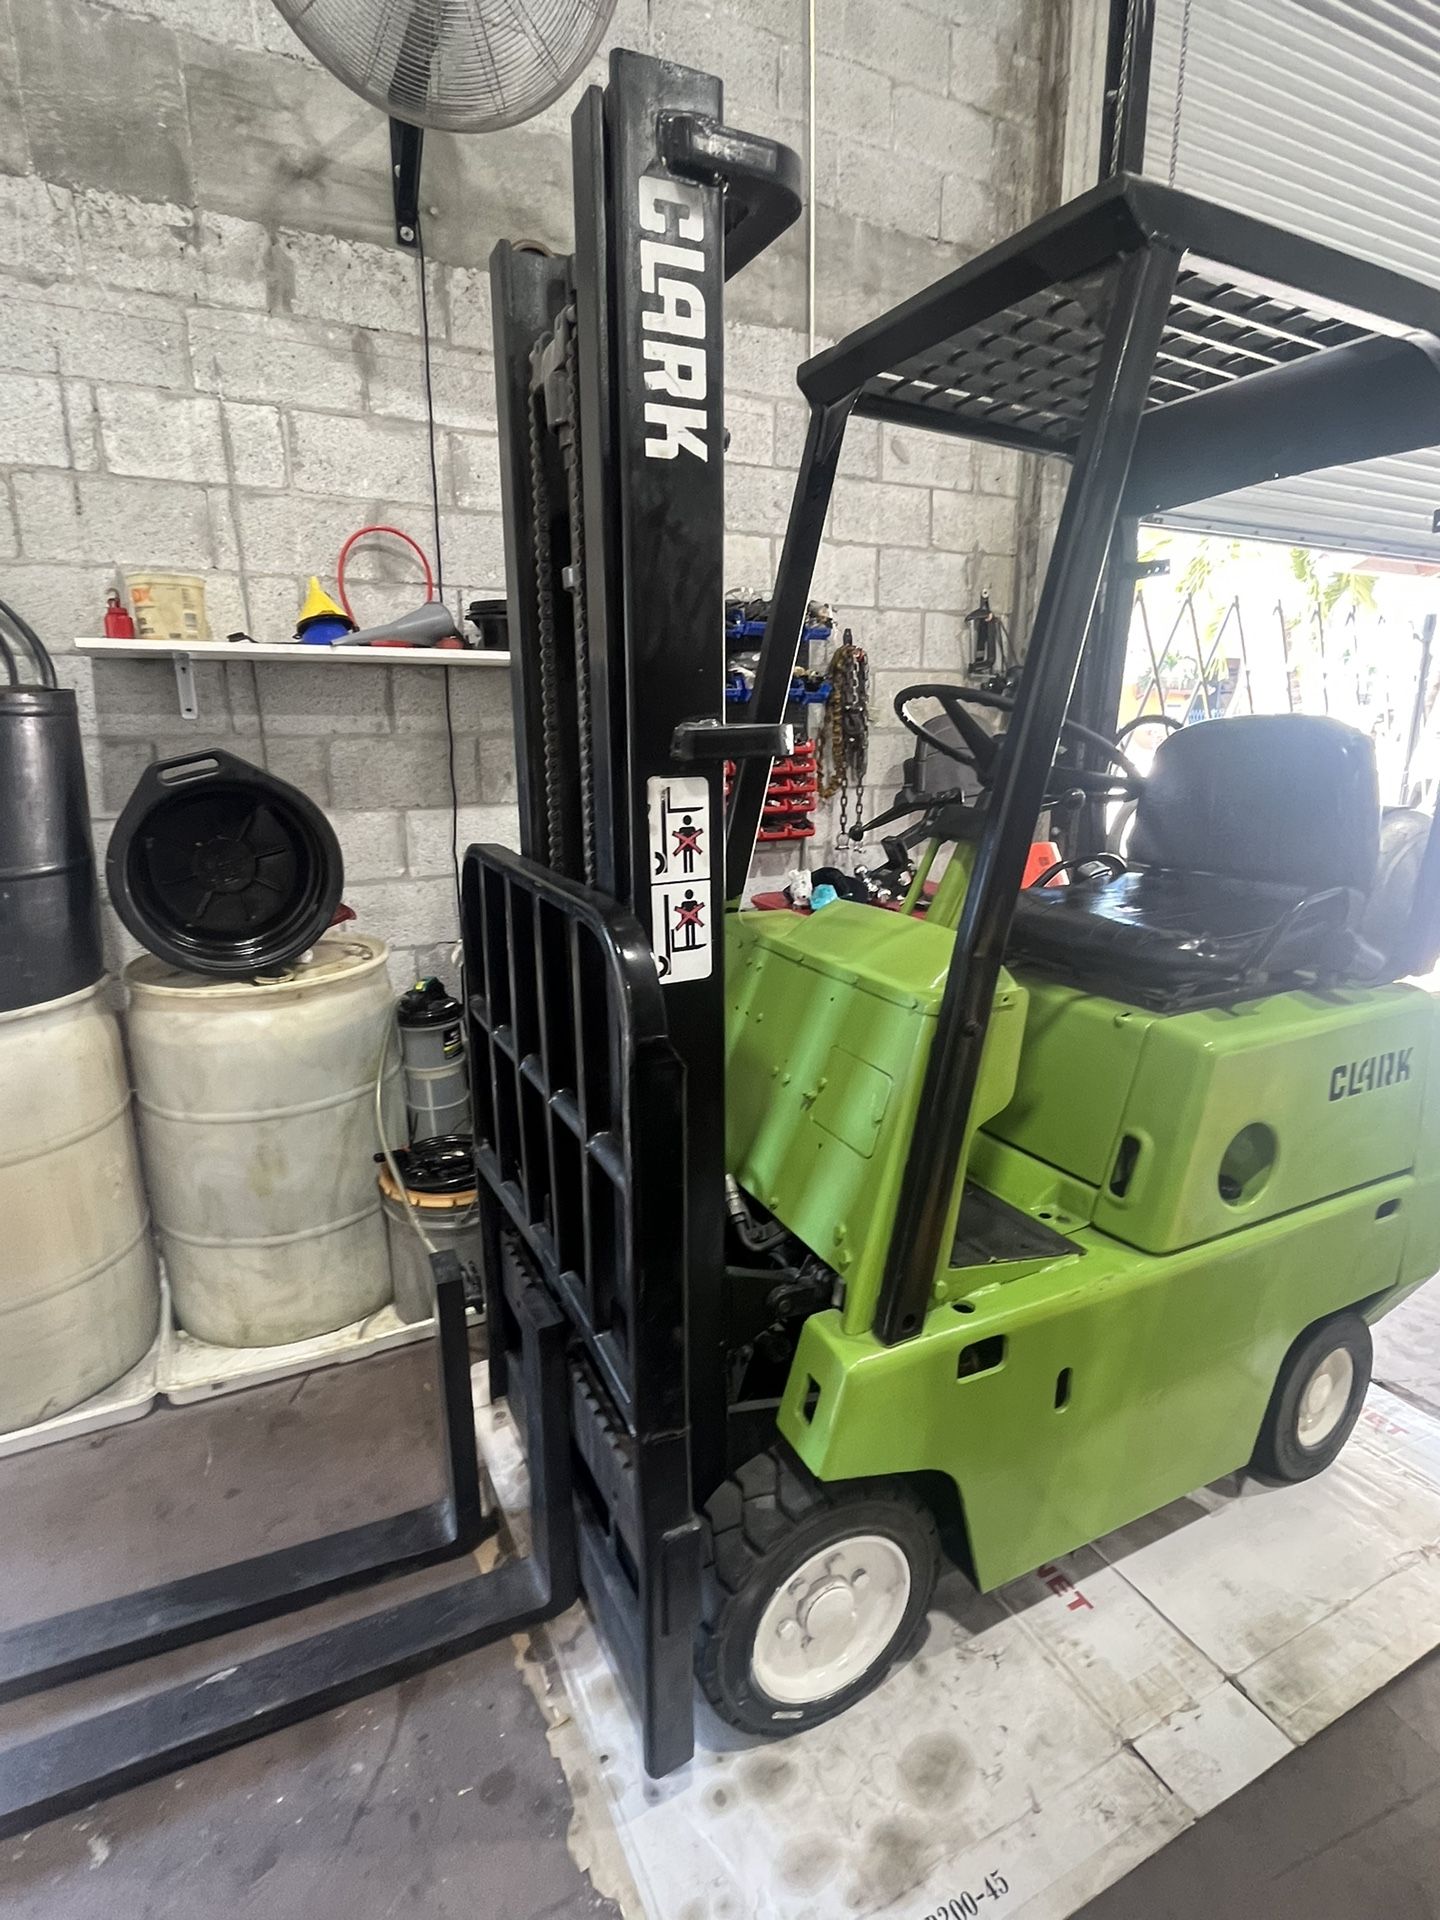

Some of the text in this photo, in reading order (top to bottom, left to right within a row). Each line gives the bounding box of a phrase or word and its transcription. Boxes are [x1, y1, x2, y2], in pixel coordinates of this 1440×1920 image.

[639, 175, 708, 463] CLARK
[1328, 1047, 1414, 1102] CLARK
[924, 1869, 1009, 1920] 200-45
